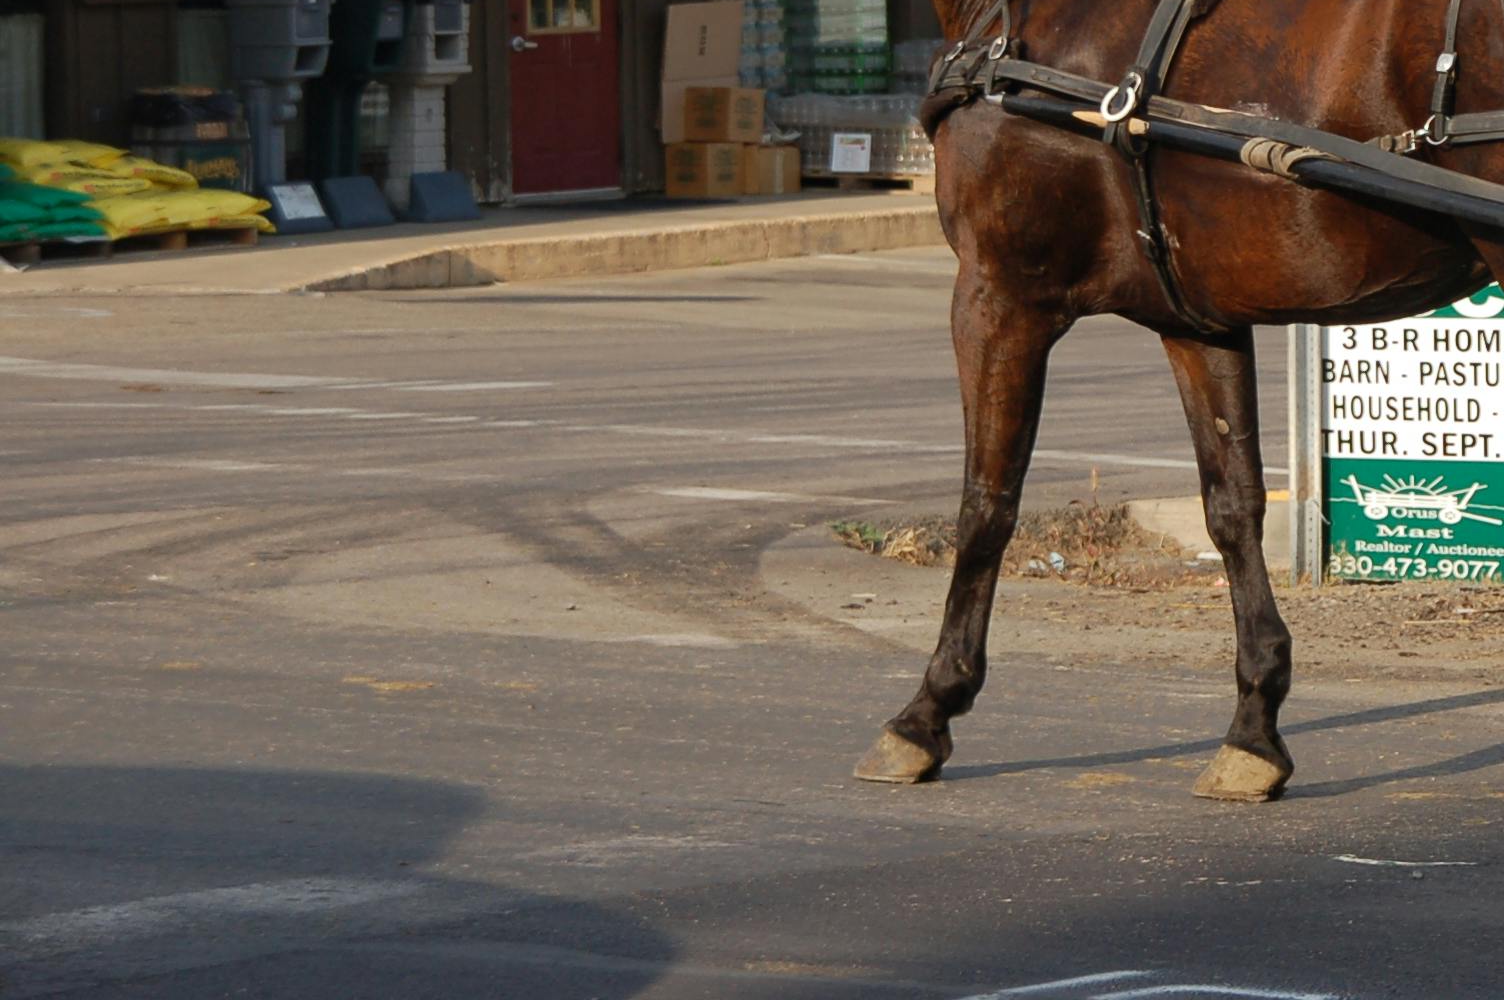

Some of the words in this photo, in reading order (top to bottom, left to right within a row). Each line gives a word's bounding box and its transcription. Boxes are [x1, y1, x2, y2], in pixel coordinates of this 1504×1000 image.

[1342, 327, 1357, 350] 3
[1372, 328, 1420, 351] B-R
[1322, 358, 1389, 384] BARN
[1333, 395, 1480, 422] HOUSEHOLD
[1322, 430, 1408, 455] THUR.
[1422, 432, 1500, 458] SEPT.
[1391, 507, 1438, 520] Orus
[1376, 524, 1454, 539] Mast
[1355, 540, 1412, 555] Realtor
[1329, 555, 1500, 579] 330-473-9077
